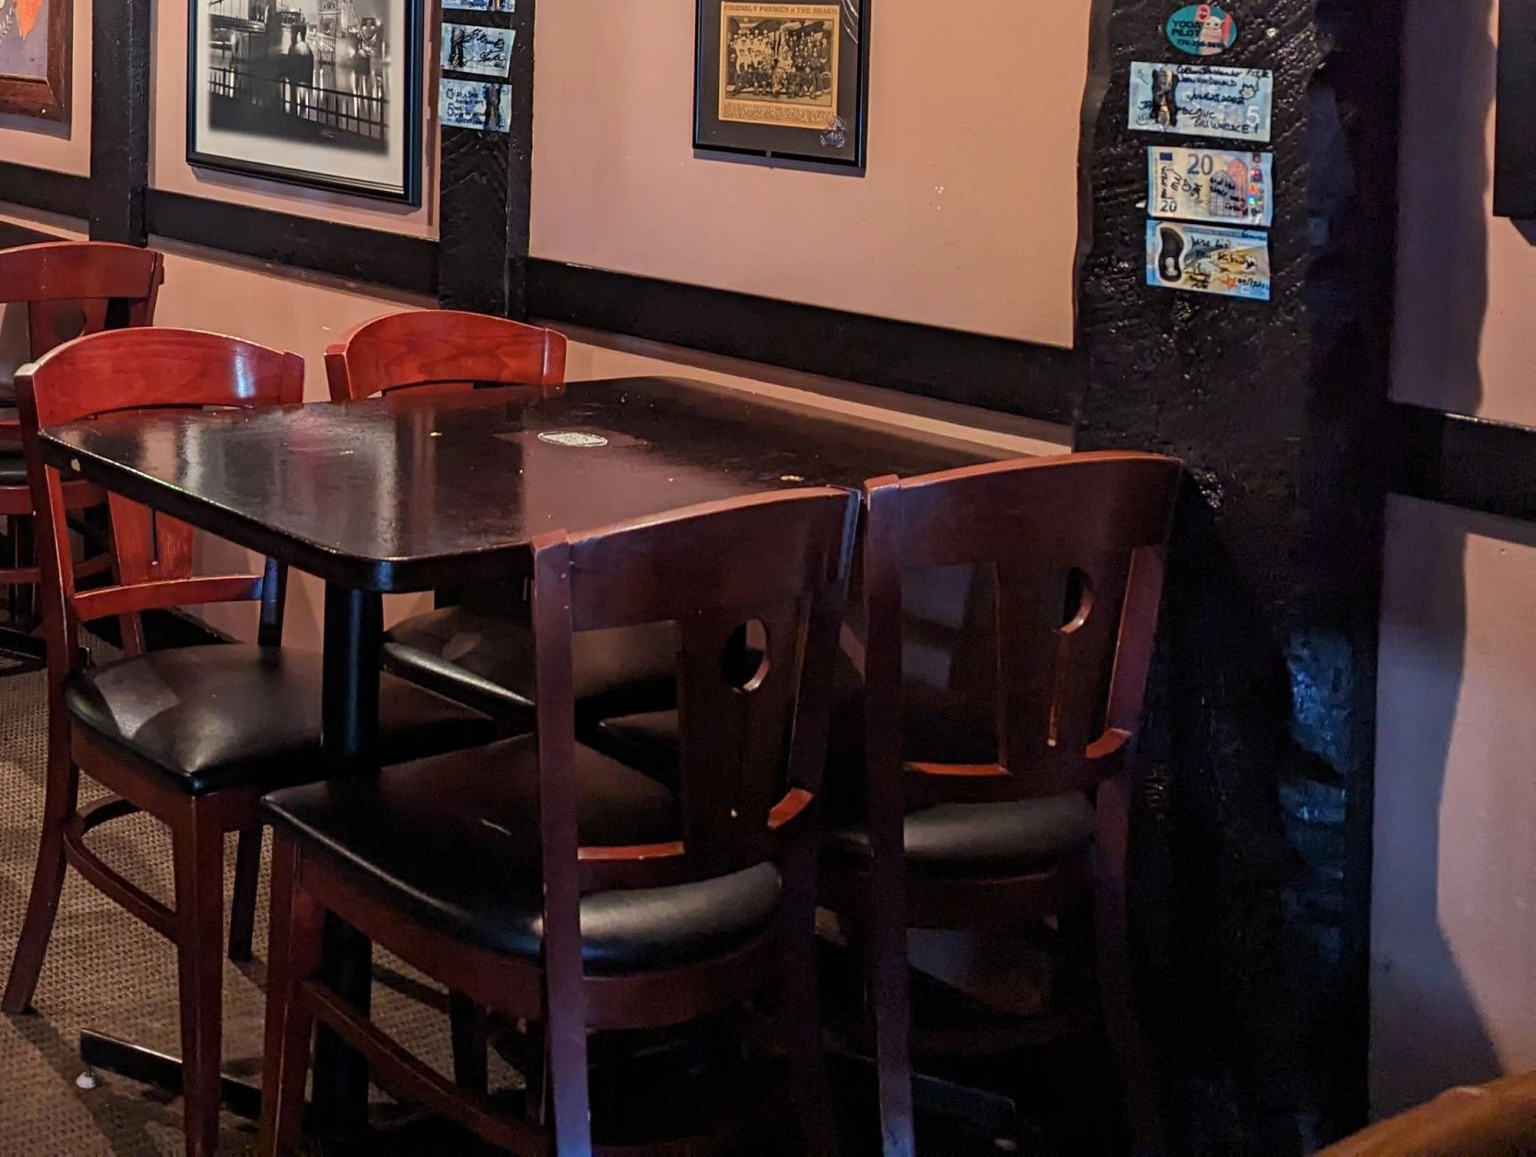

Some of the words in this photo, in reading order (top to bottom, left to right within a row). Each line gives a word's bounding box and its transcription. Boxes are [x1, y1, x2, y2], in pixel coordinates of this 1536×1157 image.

[1246, 105, 1261, 126] 5
[1187, 153, 1214, 176] 20
[1160, 200, 1177, 213] 20
